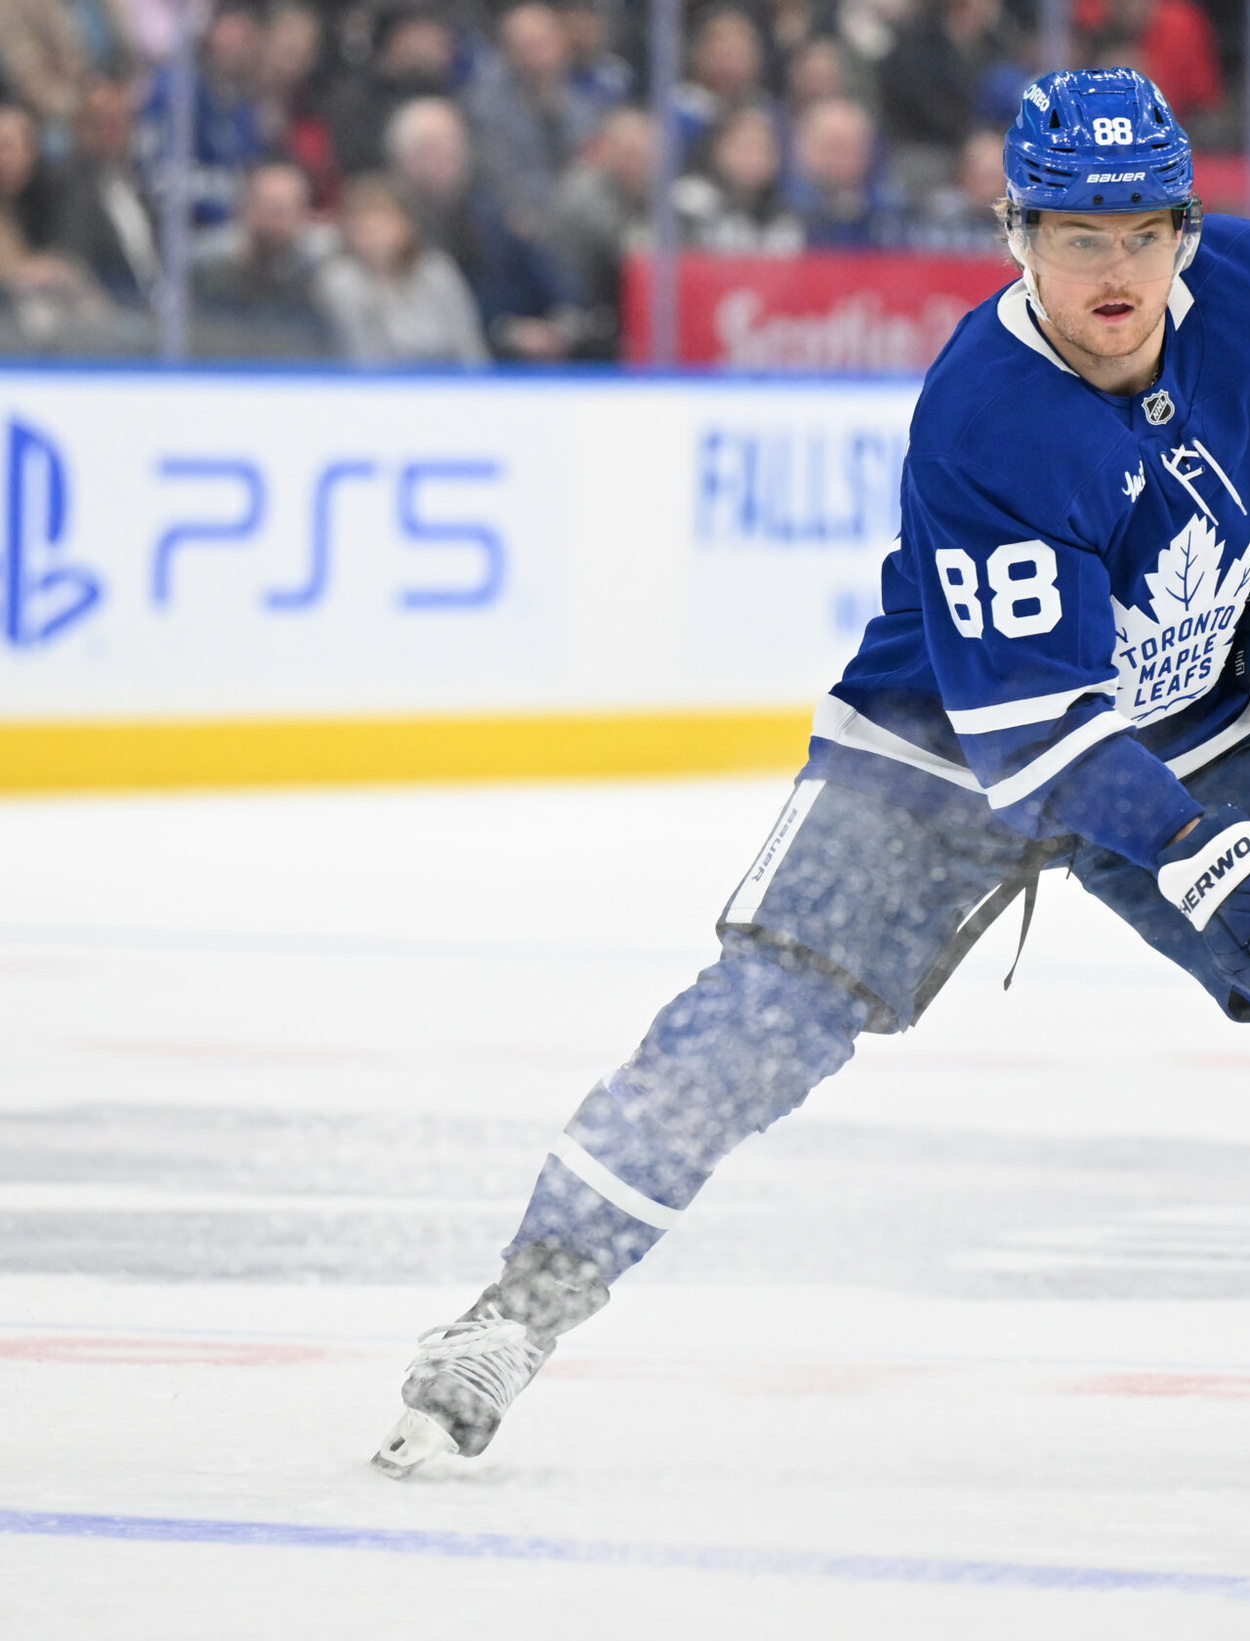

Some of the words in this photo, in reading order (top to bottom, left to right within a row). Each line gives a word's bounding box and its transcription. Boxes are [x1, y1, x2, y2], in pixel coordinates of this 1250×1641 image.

[1023, 84, 1050, 112] OREO
[1092, 117, 1133, 146] 88
[1086, 172, 1146, 183] BAUER
[154, 459, 506, 611] PS5
[935, 539, 1063, 640] 88
[1119, 605, 1236, 669] TORONTO
[1139, 632, 1218, 685] MAPLE
[1133, 656, 1213, 707] LEAFS
[752, 808, 798, 882] BAUER
